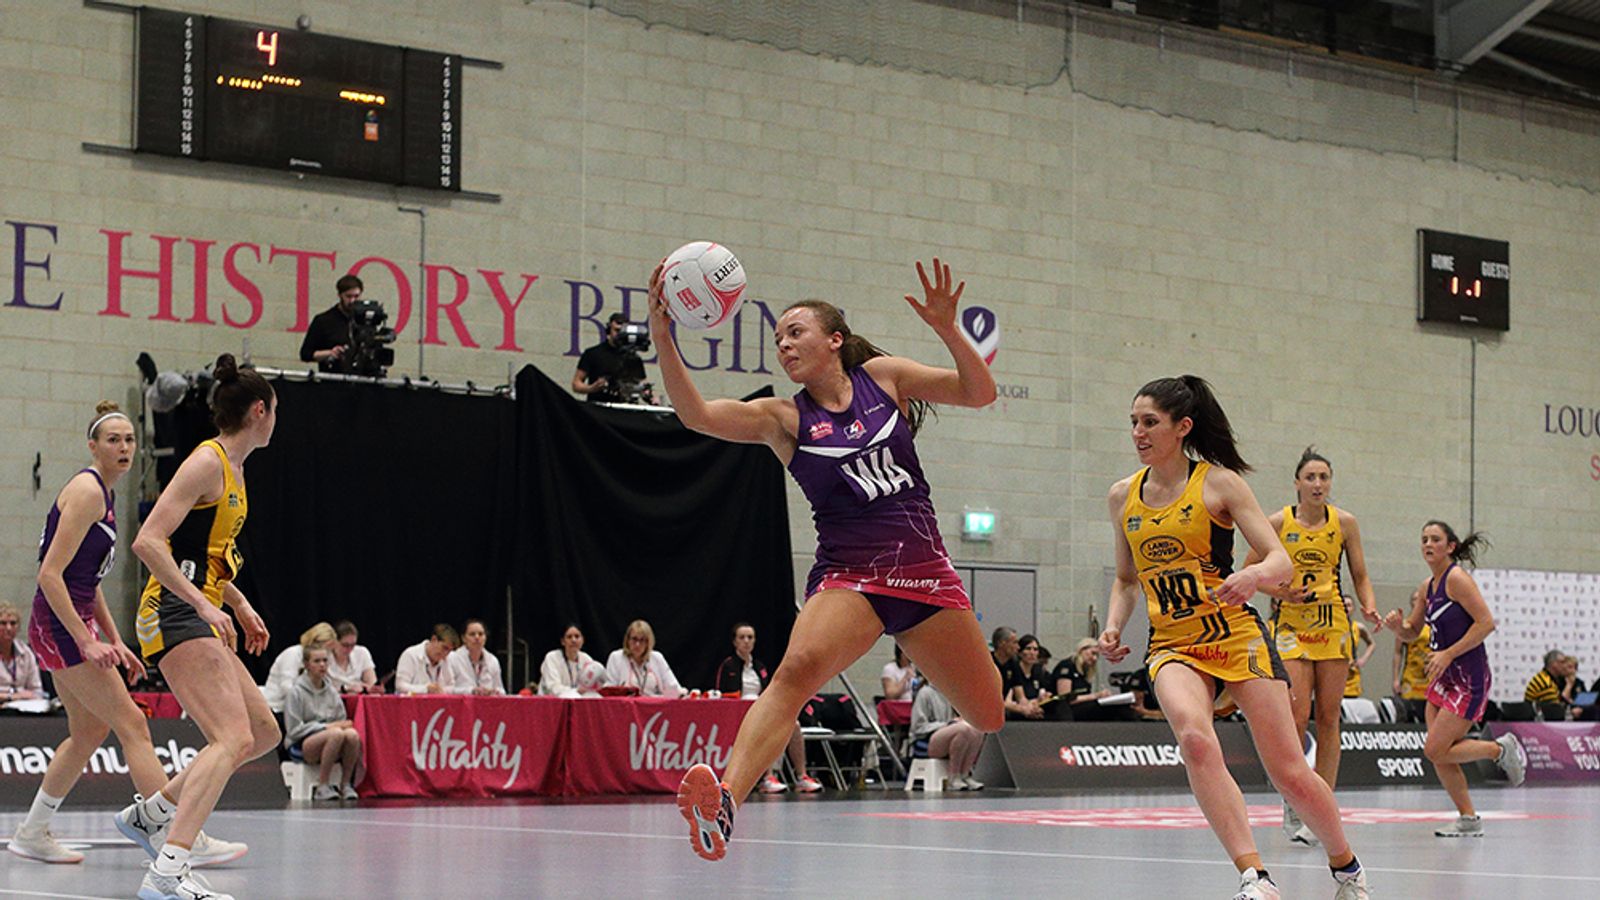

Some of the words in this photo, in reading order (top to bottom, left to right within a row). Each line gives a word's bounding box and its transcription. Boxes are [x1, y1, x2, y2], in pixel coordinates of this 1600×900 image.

[184, 17, 193, 27] 4
[185, 28, 193, 39] 5
[184, 40, 193, 51] 6
[257, 31, 278, 66] 4
[185, 51, 192, 61] 7
[443, 56, 450, 66] 4
[183, 62, 192, 73] 8
[443, 67, 451, 77] 5
[184, 74, 192, 85] 9
[443, 78, 451, 88] 6
[182, 86, 194, 97] 10
[443, 89, 450, 99] 7
[182, 97, 193, 108] 11
[443, 100, 451, 110] 8
[182, 108, 193, 119] 12
[442, 111, 450, 121] 9
[181, 120, 192, 131] 13
[441, 122, 452, 132] 10
[441, 133, 452, 143] 11
[441, 144, 451, 154] 12
[441, 155, 451, 165] 13
[1431, 253, 1455, 273] HOME
[97, 229, 539, 353] HISTORY
[841, 446, 914, 502] WA
[1149, 572, 1204, 616] WD
[411, 708, 522, 789] Vitality
[1566, 736, 1585, 752] BE
[1377, 758, 1424, 777] SPORT
[1573, 753, 1600, 771] YOU
